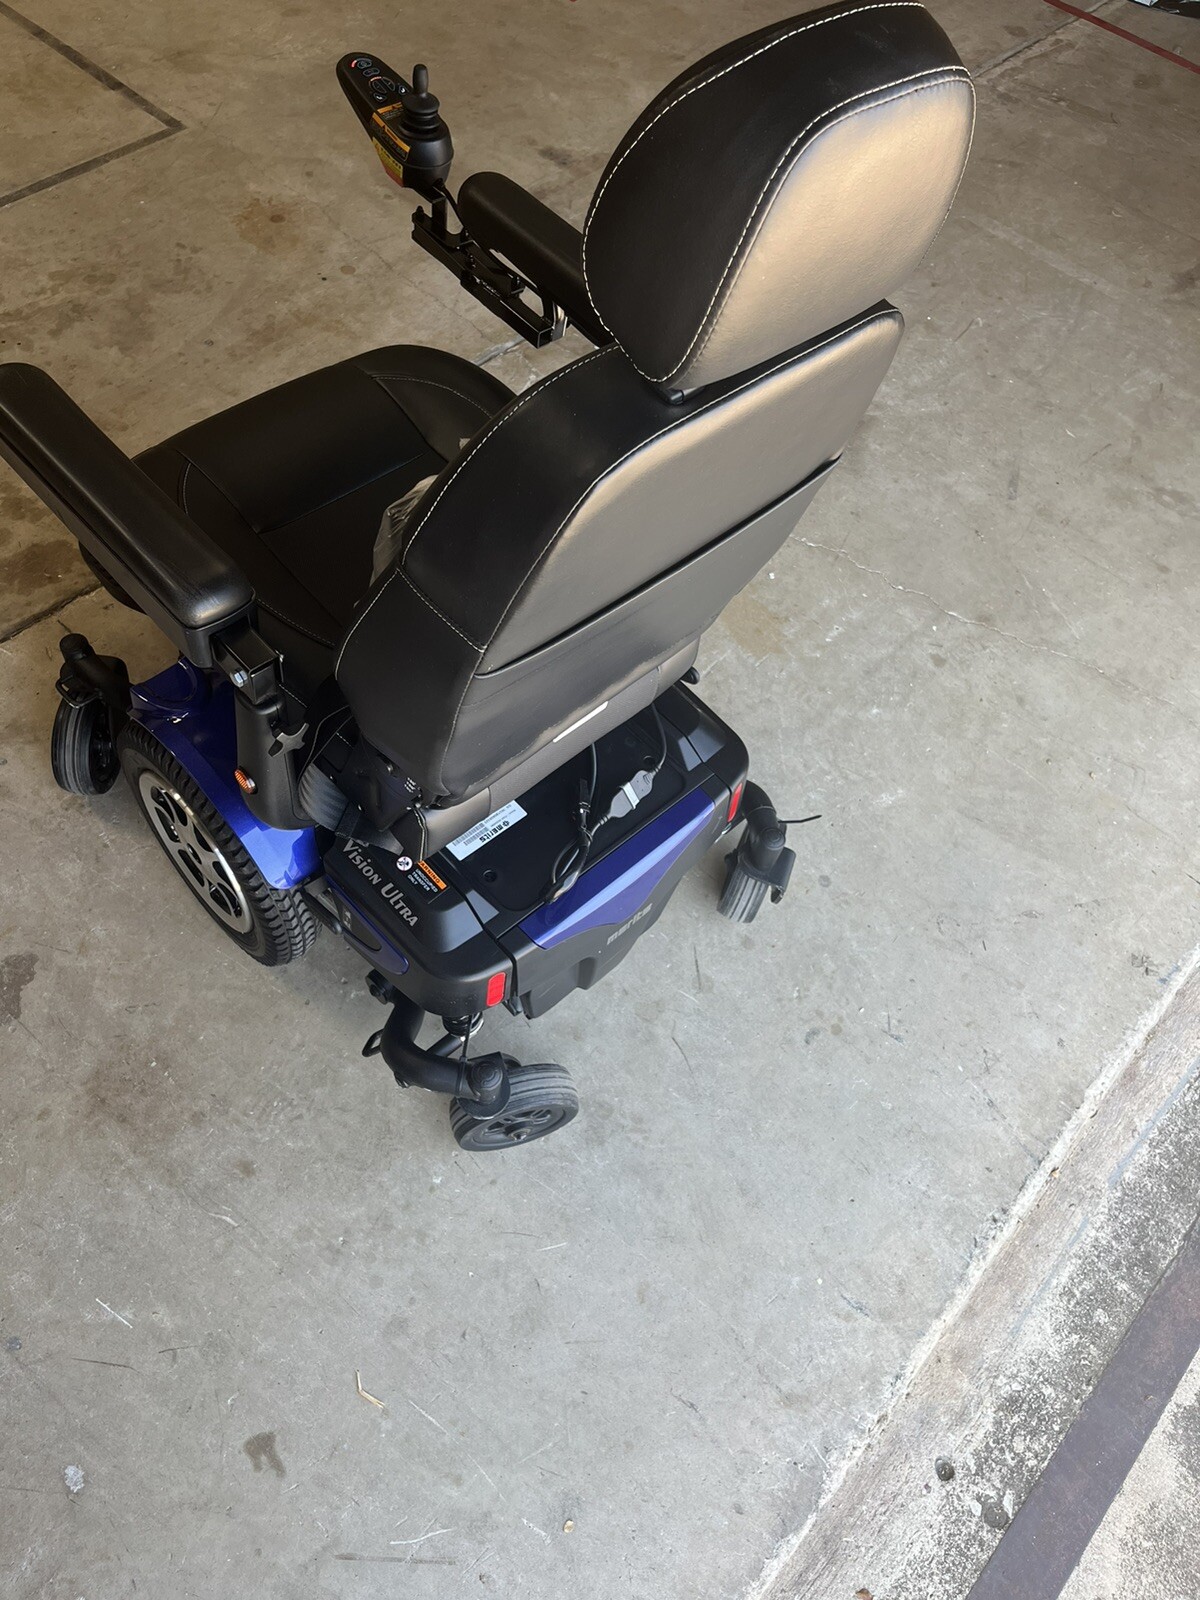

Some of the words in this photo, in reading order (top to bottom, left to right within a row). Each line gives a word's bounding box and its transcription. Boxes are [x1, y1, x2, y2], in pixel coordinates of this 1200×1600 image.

[407, 874, 418, 885] ONLY
[412, 871, 431, 892] TRANSFER
[418, 860, 441, 884] ARNING
